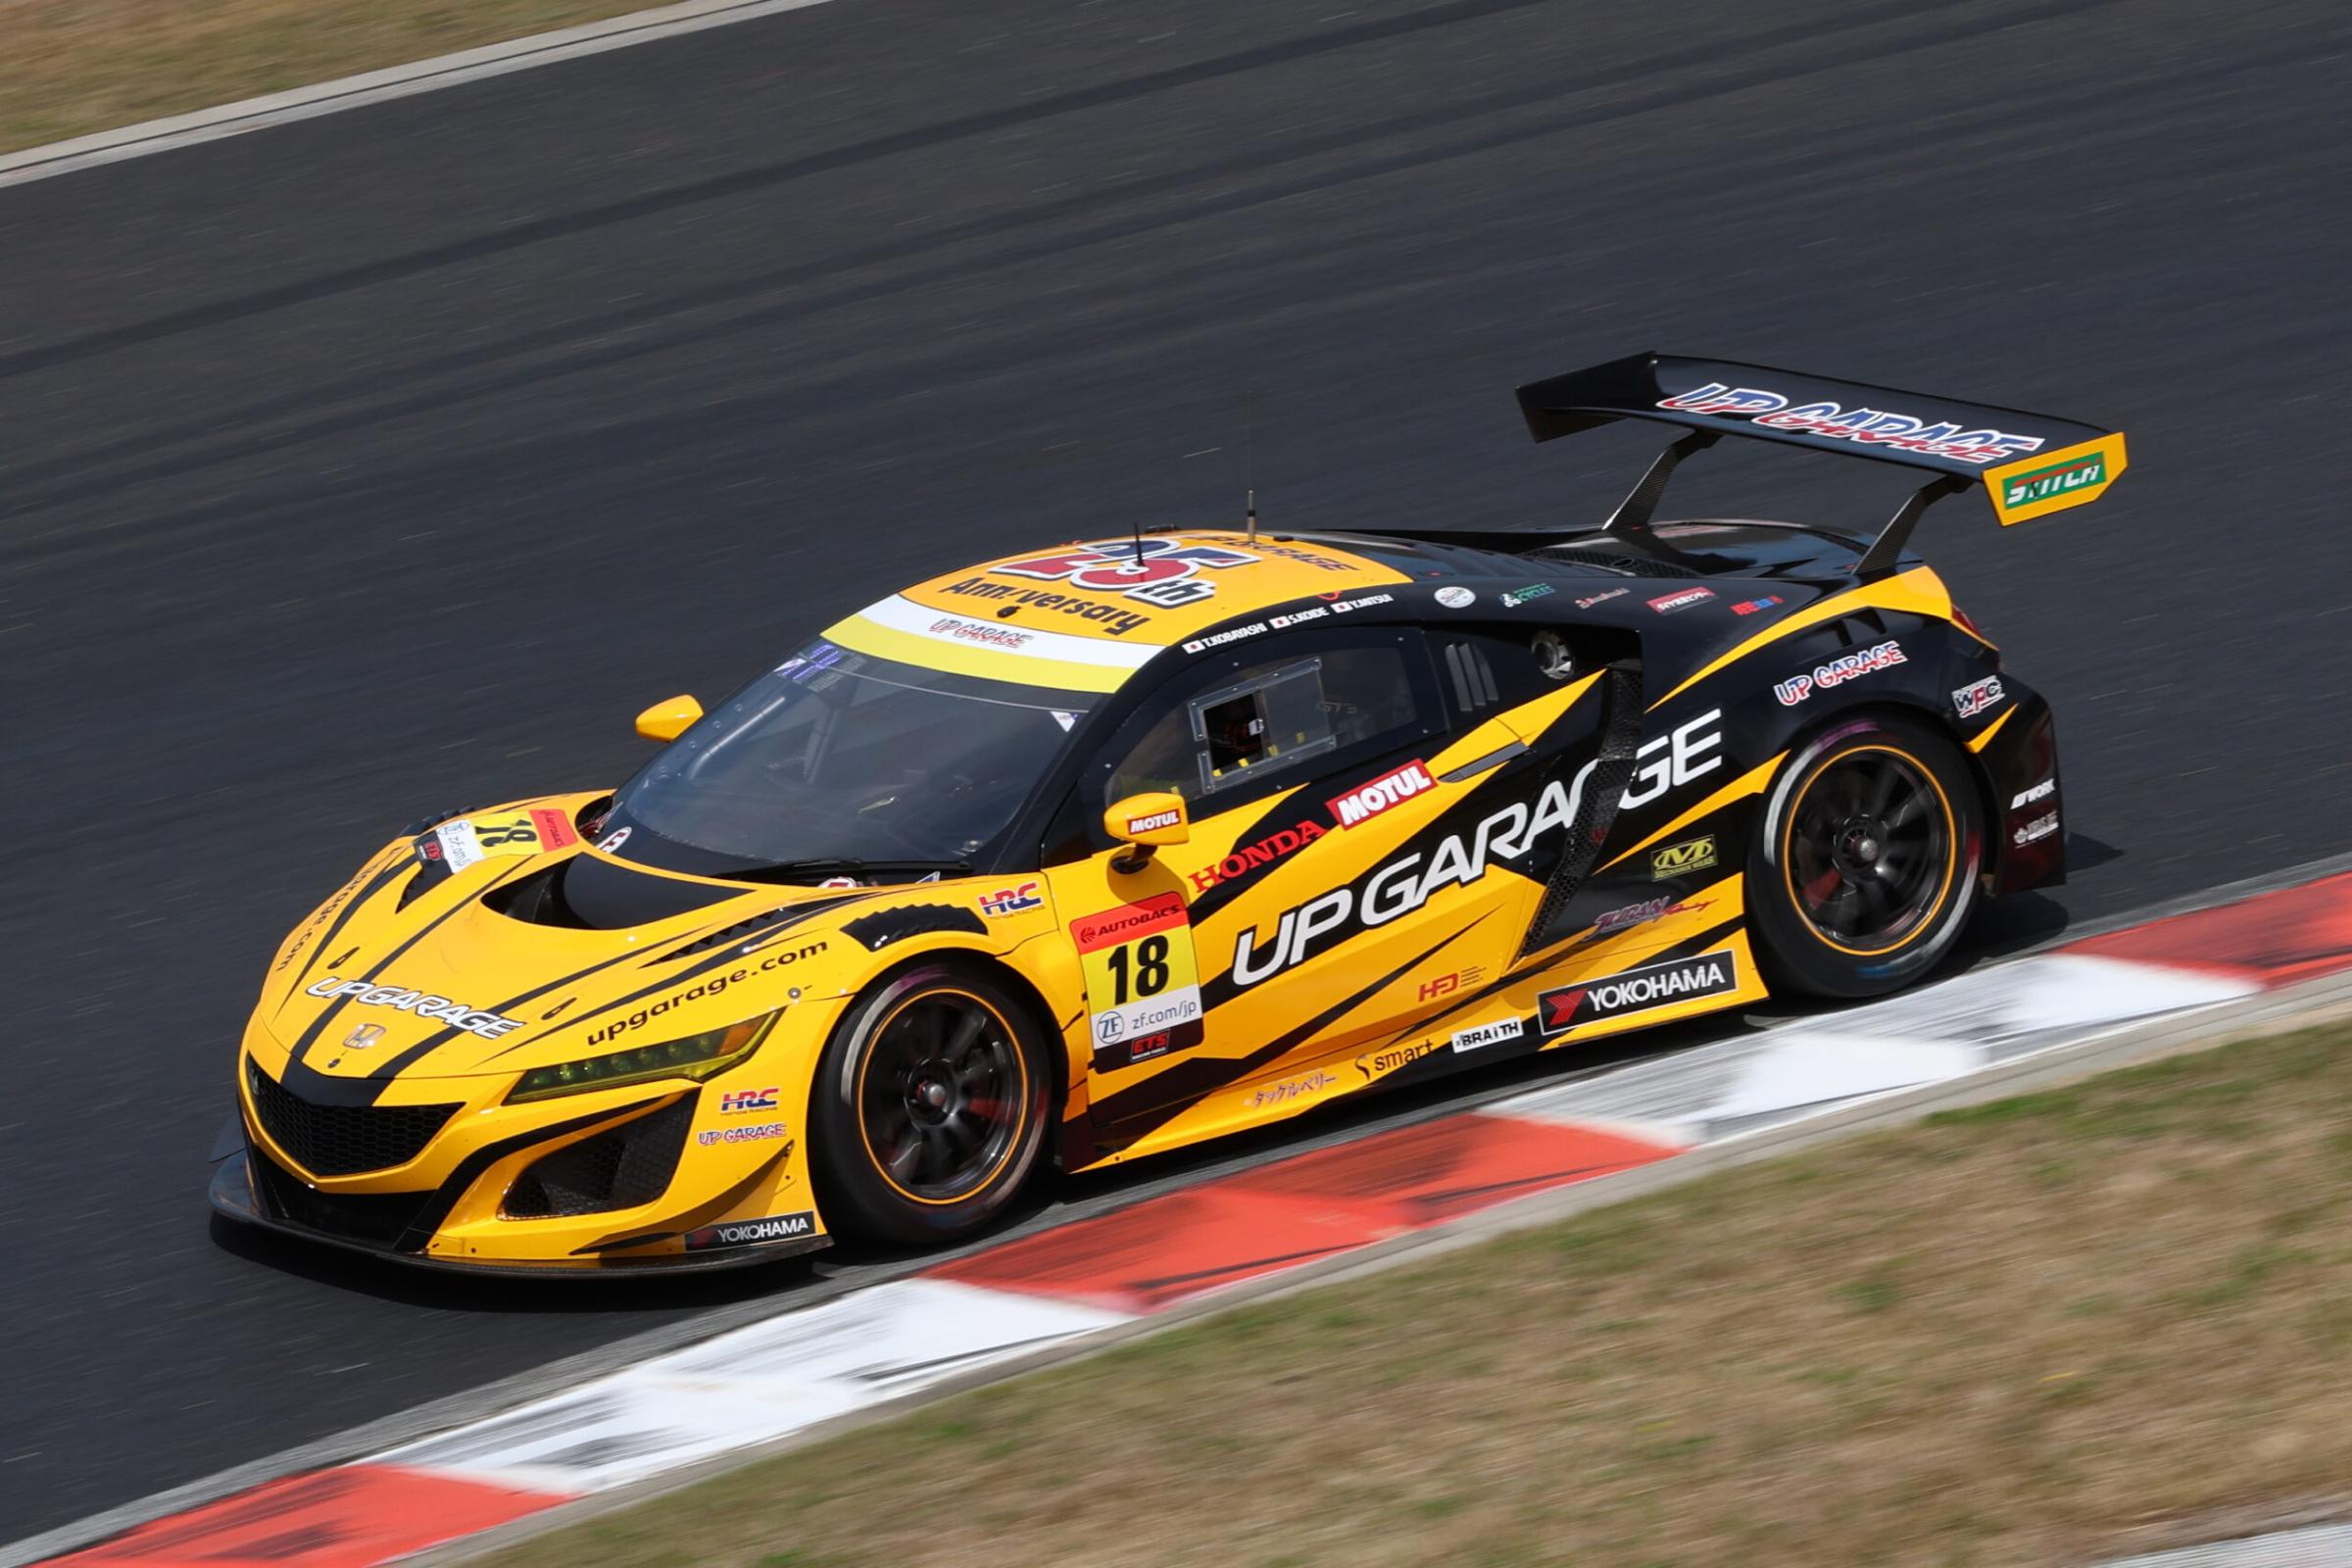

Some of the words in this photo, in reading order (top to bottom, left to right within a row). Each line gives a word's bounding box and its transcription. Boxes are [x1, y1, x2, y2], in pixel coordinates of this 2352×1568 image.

[1656, 382, 1788, 415] UP
[1752, 402, 2045, 465] GARAGE
[940, 577, 1151, 635] Anniversary
[1288, 606, 1330, 625] S.KOIDE
[928, 618, 961, 633] UP
[954, 623, 1035, 648] GARAGE
[1202, 622, 1268, 649] T.KOBAYASHI
[1774, 675, 1813, 706] UP
[1814, 641, 1908, 688] GARAGE
[1954, 680, 2002, 710] WPC
[1337, 765, 1431, 826] MOTUL
[1129, 811, 1180, 832] MOTUL
[1188, 819, 1330, 894] HONDA
[979, 882, 1042, 914] HRC
[1098, 905, 1182, 936] AUTOBACS
[1232, 885, 1352, 986] UP
[1107, 935, 1169, 1005] 18
[587, 942, 828, 1046] upgarage.com
[1587, 963, 1725, 1011] YOKOHAMA
[1132, 1001, 1197, 1030] zf.com/jp
[1375, 1039, 1433, 1071] smart
[721, 1088, 779, 1111] HRC
[699, 1130, 722, 1146] UP
[723, 1123, 787, 1144] GARAGE
[718, 1218, 808, 1243] YOKOHAMA
